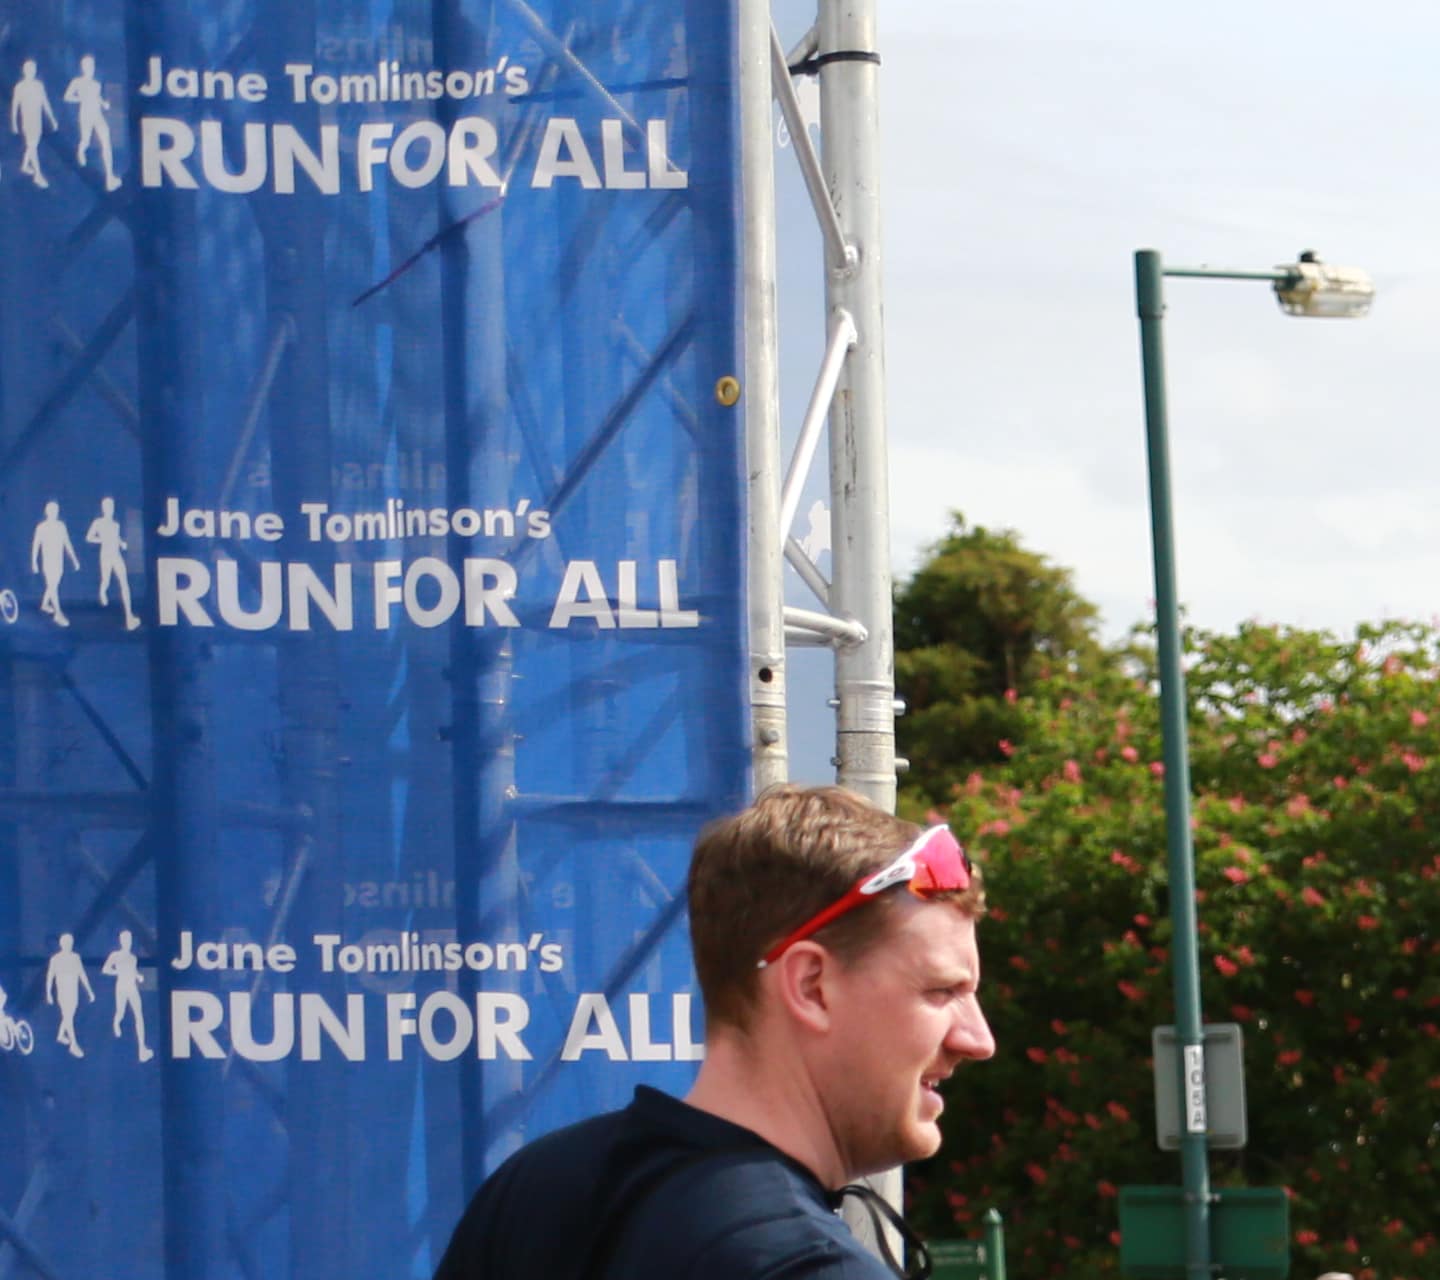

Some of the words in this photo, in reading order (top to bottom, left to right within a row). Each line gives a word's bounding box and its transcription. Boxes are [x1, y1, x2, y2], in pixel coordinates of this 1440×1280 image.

[139, 56, 268, 103] Jane
[284, 54, 530, 105] Tomlinson's
[141, 117, 340, 195] RUN
[357, 115, 507, 197] FOR
[530, 116, 688, 190] ALL
[157, 497, 284, 542] Jane
[301, 497, 552, 543] Tomlinson's
[157, 557, 353, 631] RUN
[373, 556, 521, 630] FOR
[549, 558, 701, 629] ALL
[171, 931, 297, 973] Jane
[313, 931, 564, 973] Tomlinson's
[171, 990, 366, 1062] RUN
[386, 989, 533, 1062] FOR
[558, 990, 706, 1064] ALL
